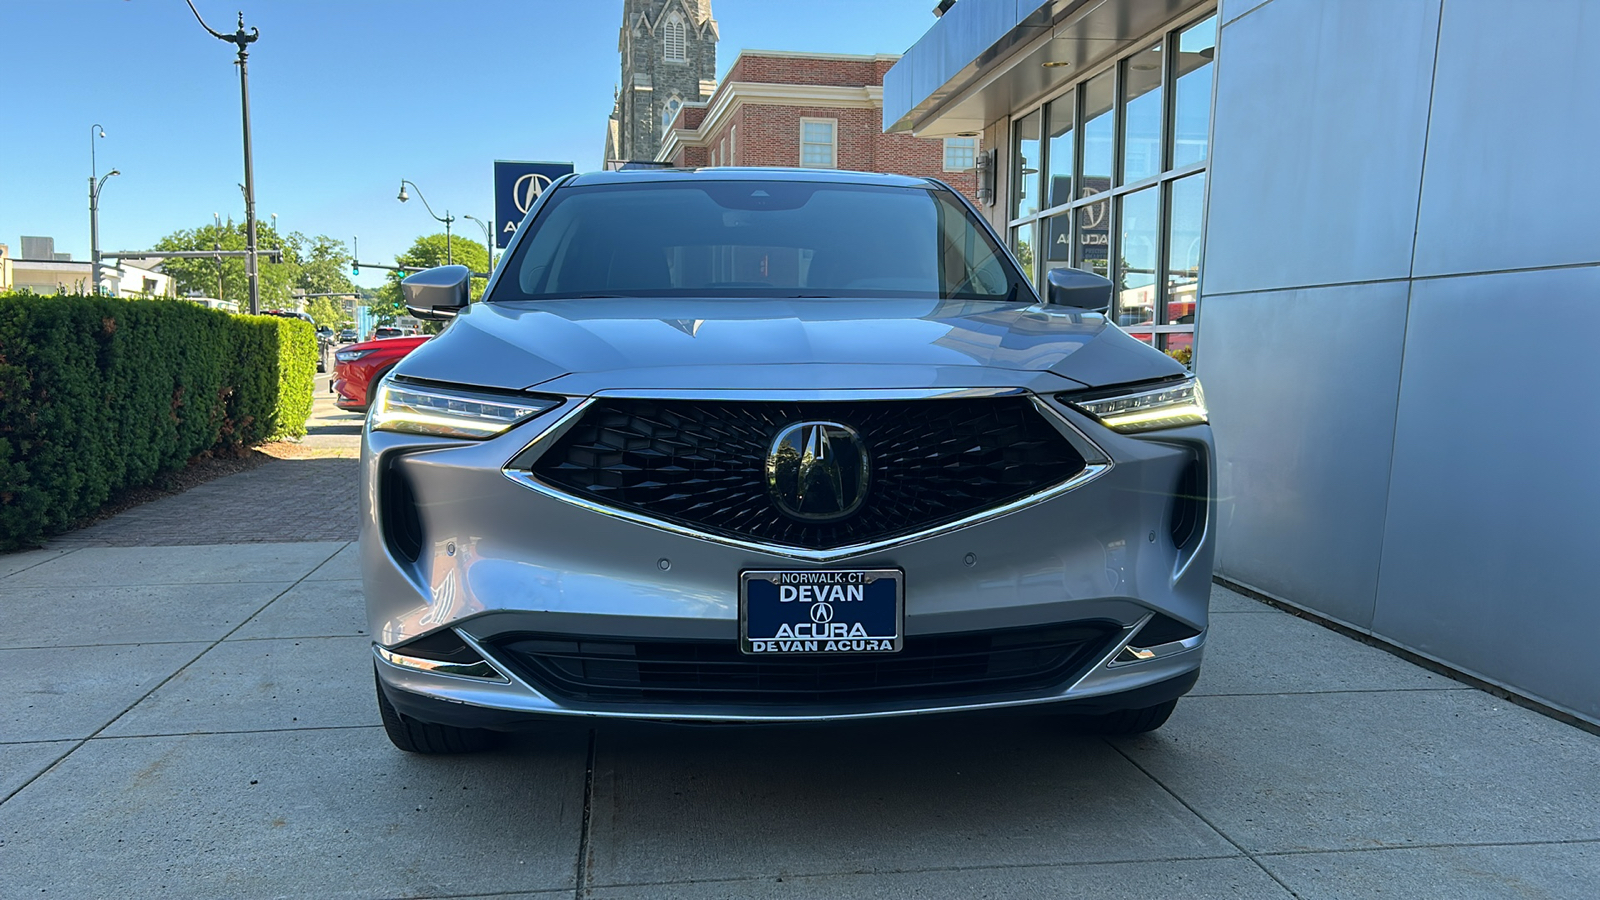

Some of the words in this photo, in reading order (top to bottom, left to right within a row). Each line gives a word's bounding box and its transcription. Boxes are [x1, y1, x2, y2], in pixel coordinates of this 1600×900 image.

[847, 572, 865, 583] CT
[779, 584, 864, 603] DEVAN
[774, 622, 868, 638] ACURA
[752, 641, 818, 652] DEVAN
[824, 639, 893, 651] ACURA
